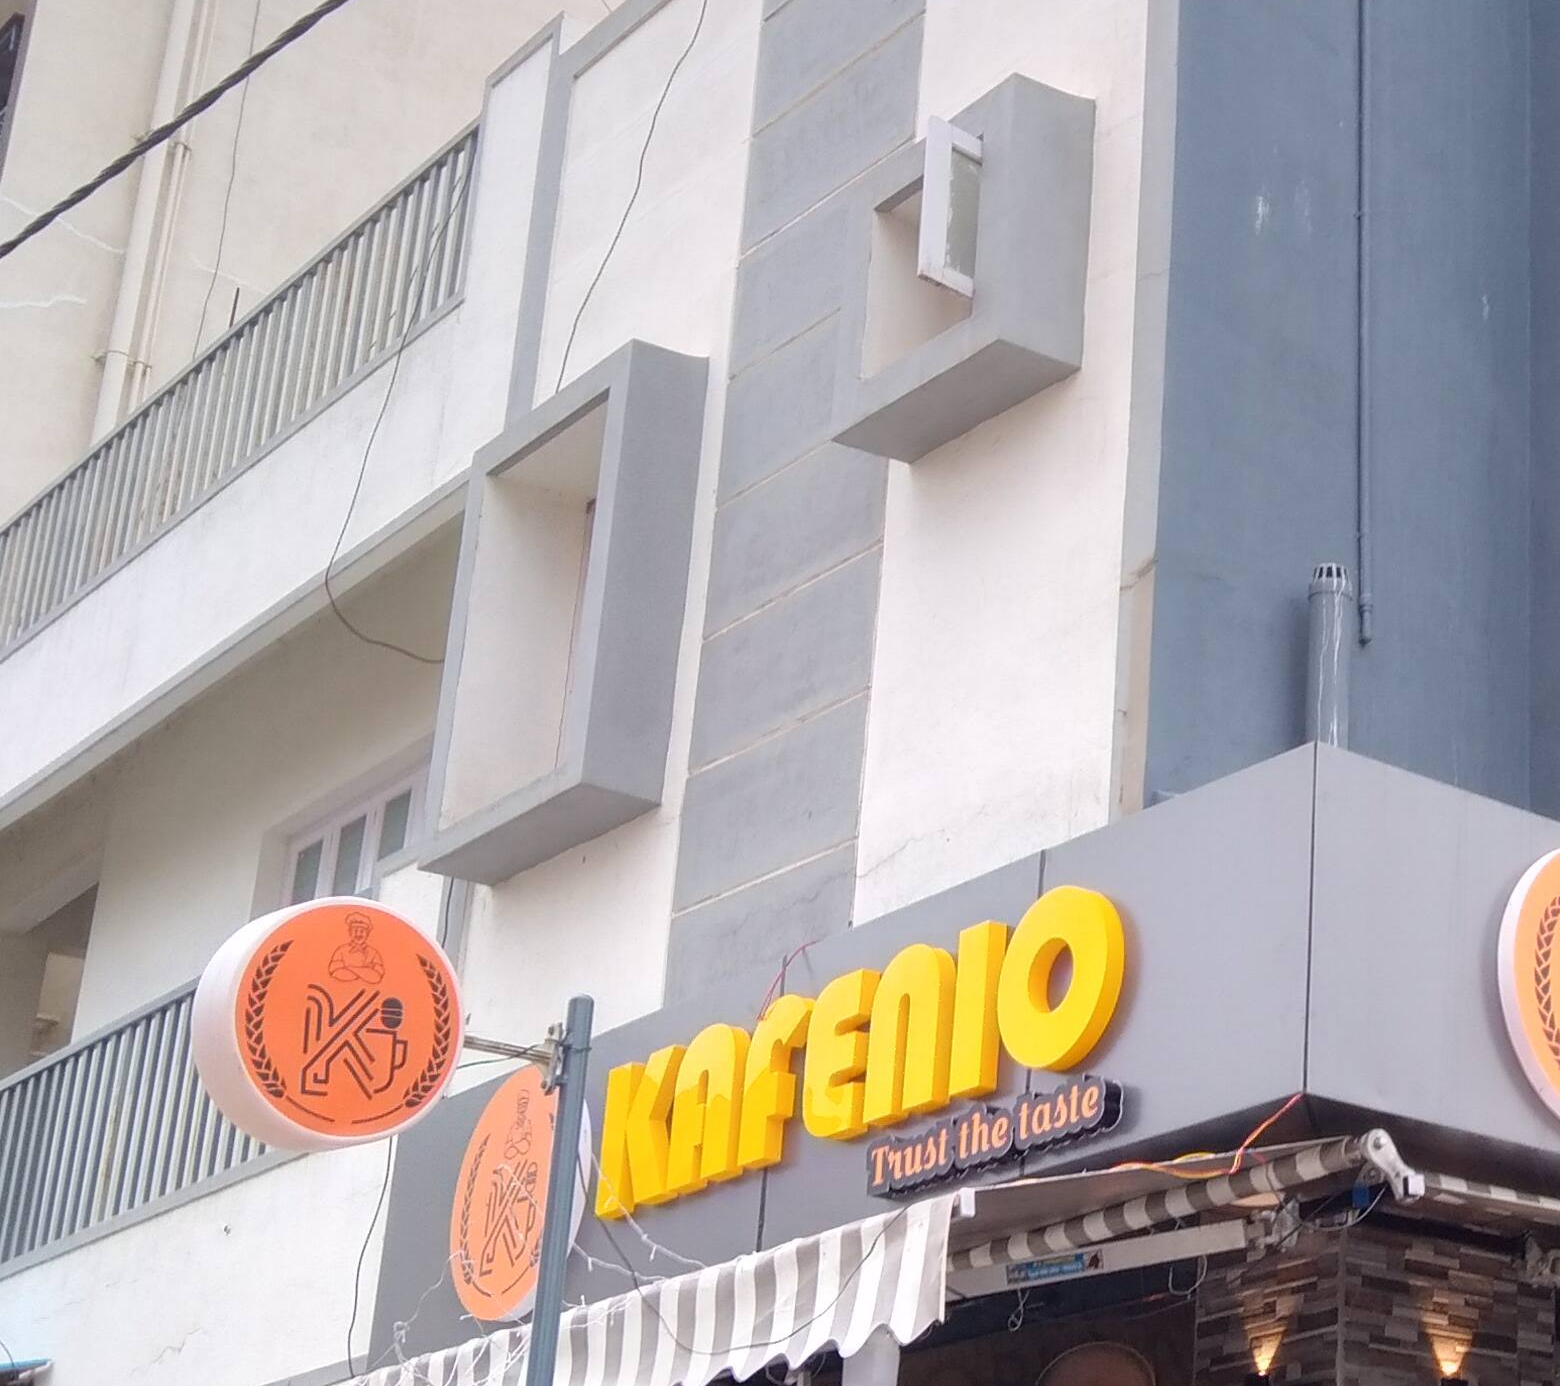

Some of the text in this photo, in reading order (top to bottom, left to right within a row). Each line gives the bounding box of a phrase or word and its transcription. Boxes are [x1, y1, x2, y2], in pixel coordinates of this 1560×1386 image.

[595, 885, 1124, 1219] KAFENIO
[871, 1084, 1099, 1187] Trust the taste
